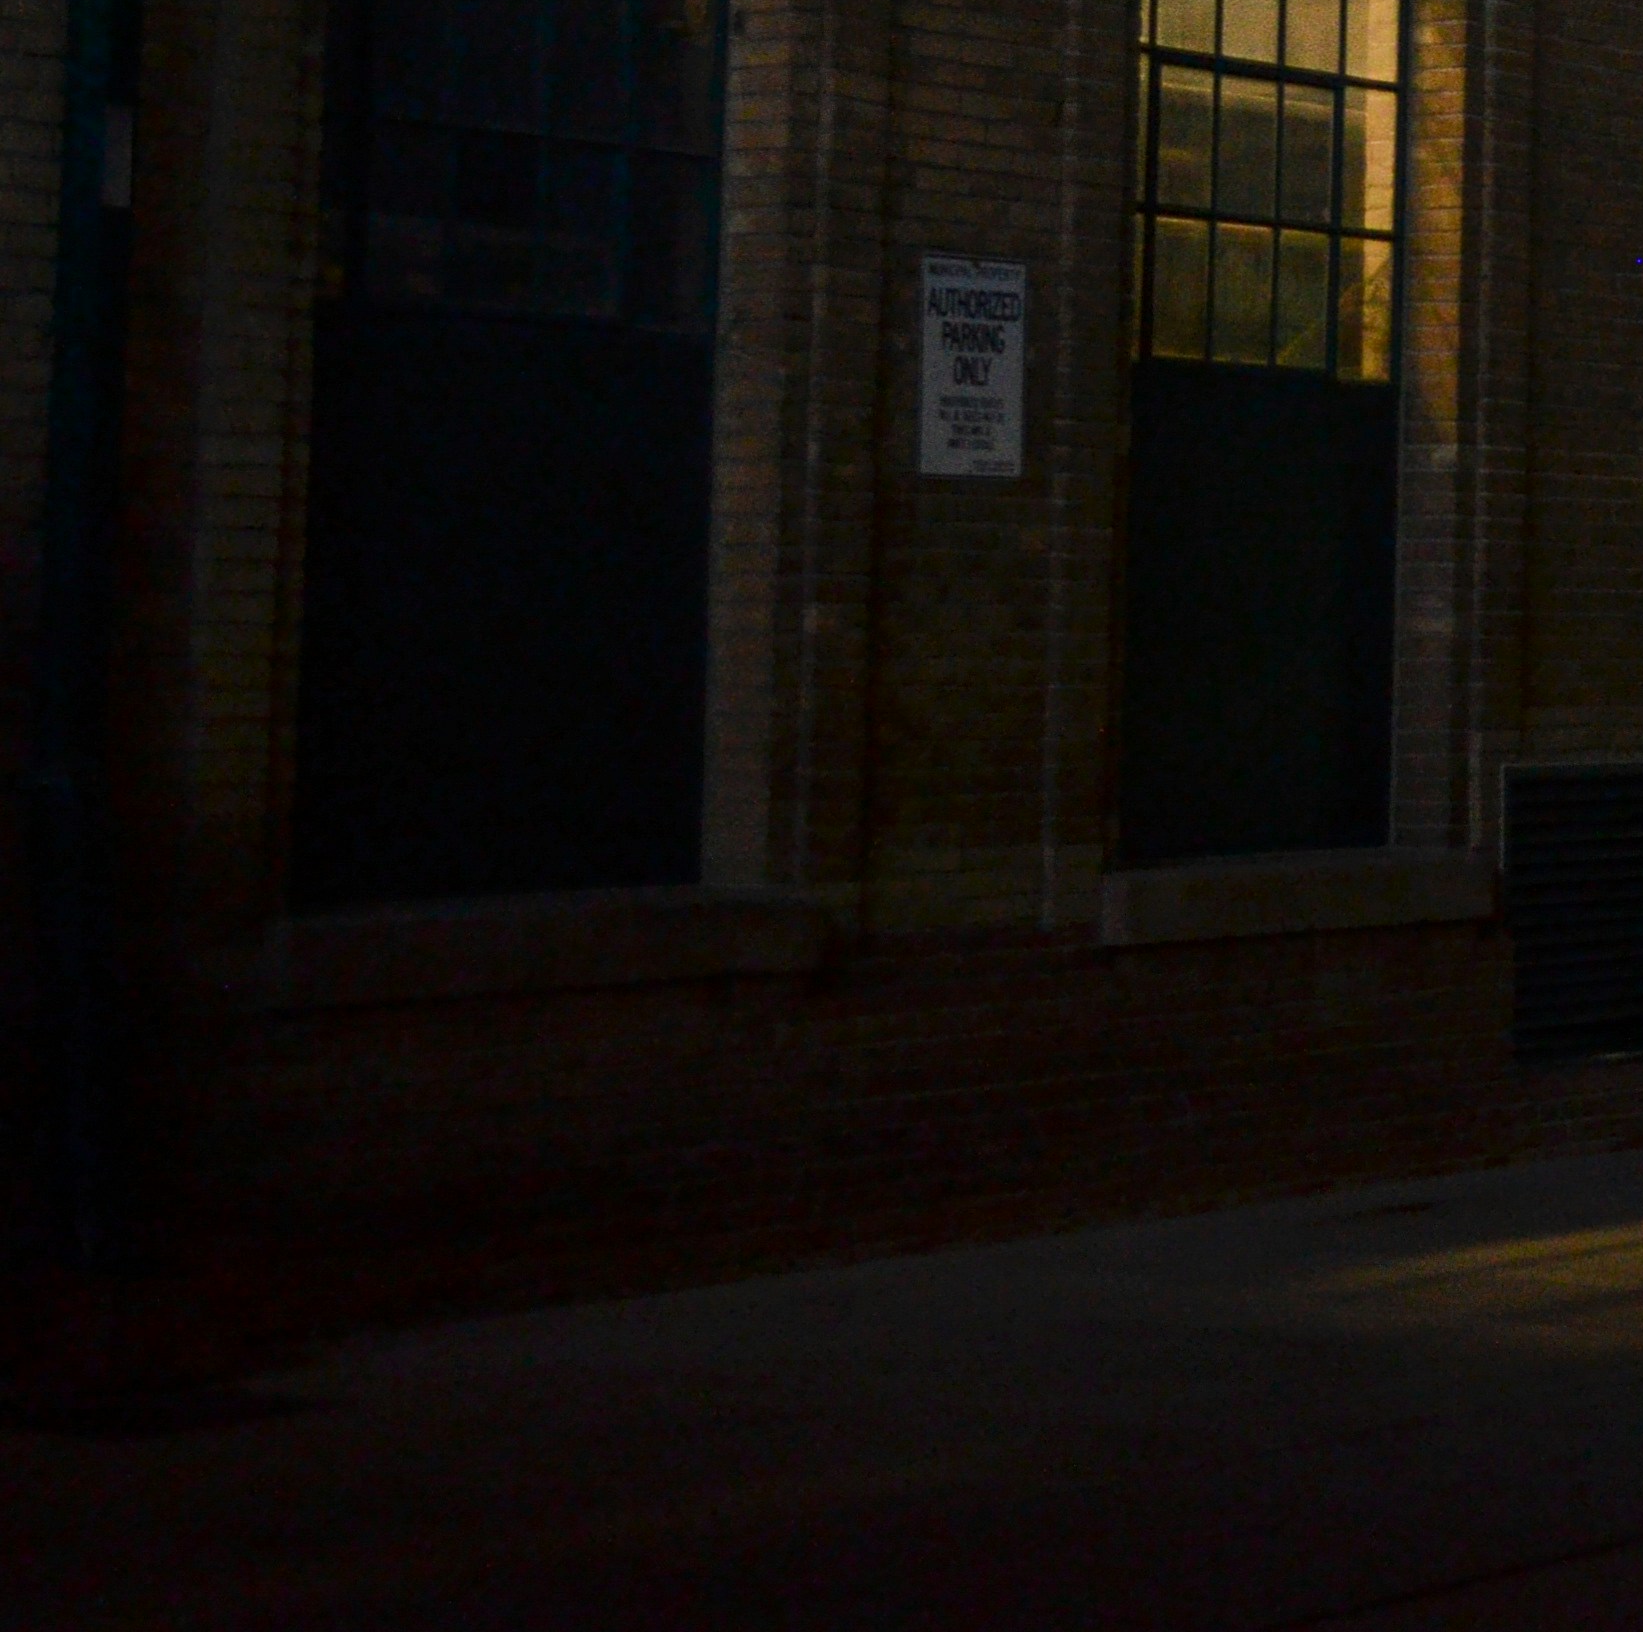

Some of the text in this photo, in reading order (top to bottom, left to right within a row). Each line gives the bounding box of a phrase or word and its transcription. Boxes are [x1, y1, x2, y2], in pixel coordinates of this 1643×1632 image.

[928, 287, 1021, 322] AUTHORIZED
[942, 321, 1006, 354] PARKING
[954, 356, 994, 386] ONLY
